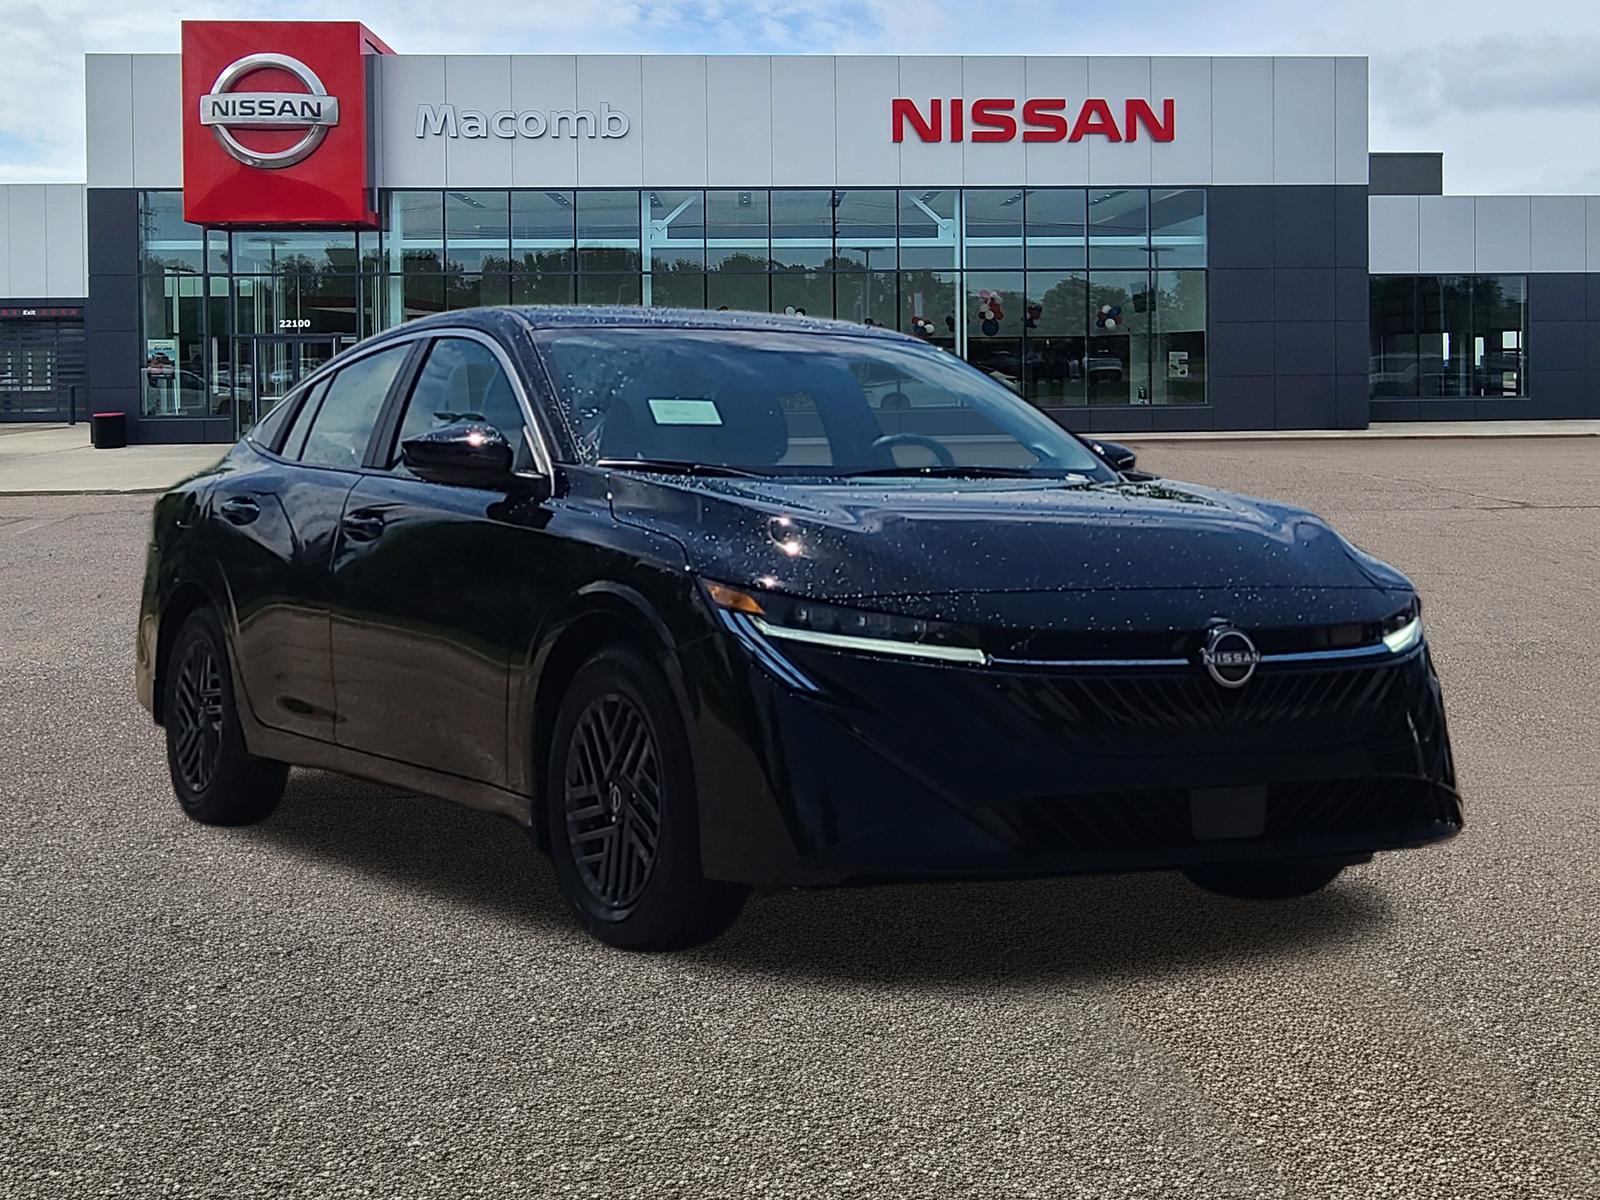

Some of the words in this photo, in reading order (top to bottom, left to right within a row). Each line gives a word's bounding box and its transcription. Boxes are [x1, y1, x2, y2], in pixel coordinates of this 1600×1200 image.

[212, 100, 321, 117] NISSAN
[415, 102, 629, 139] Macomb
[892, 98, 1175, 143] NISSAN
[279, 319, 311, 328] 22100
[1203, 652, 1260, 664] NISSAN
